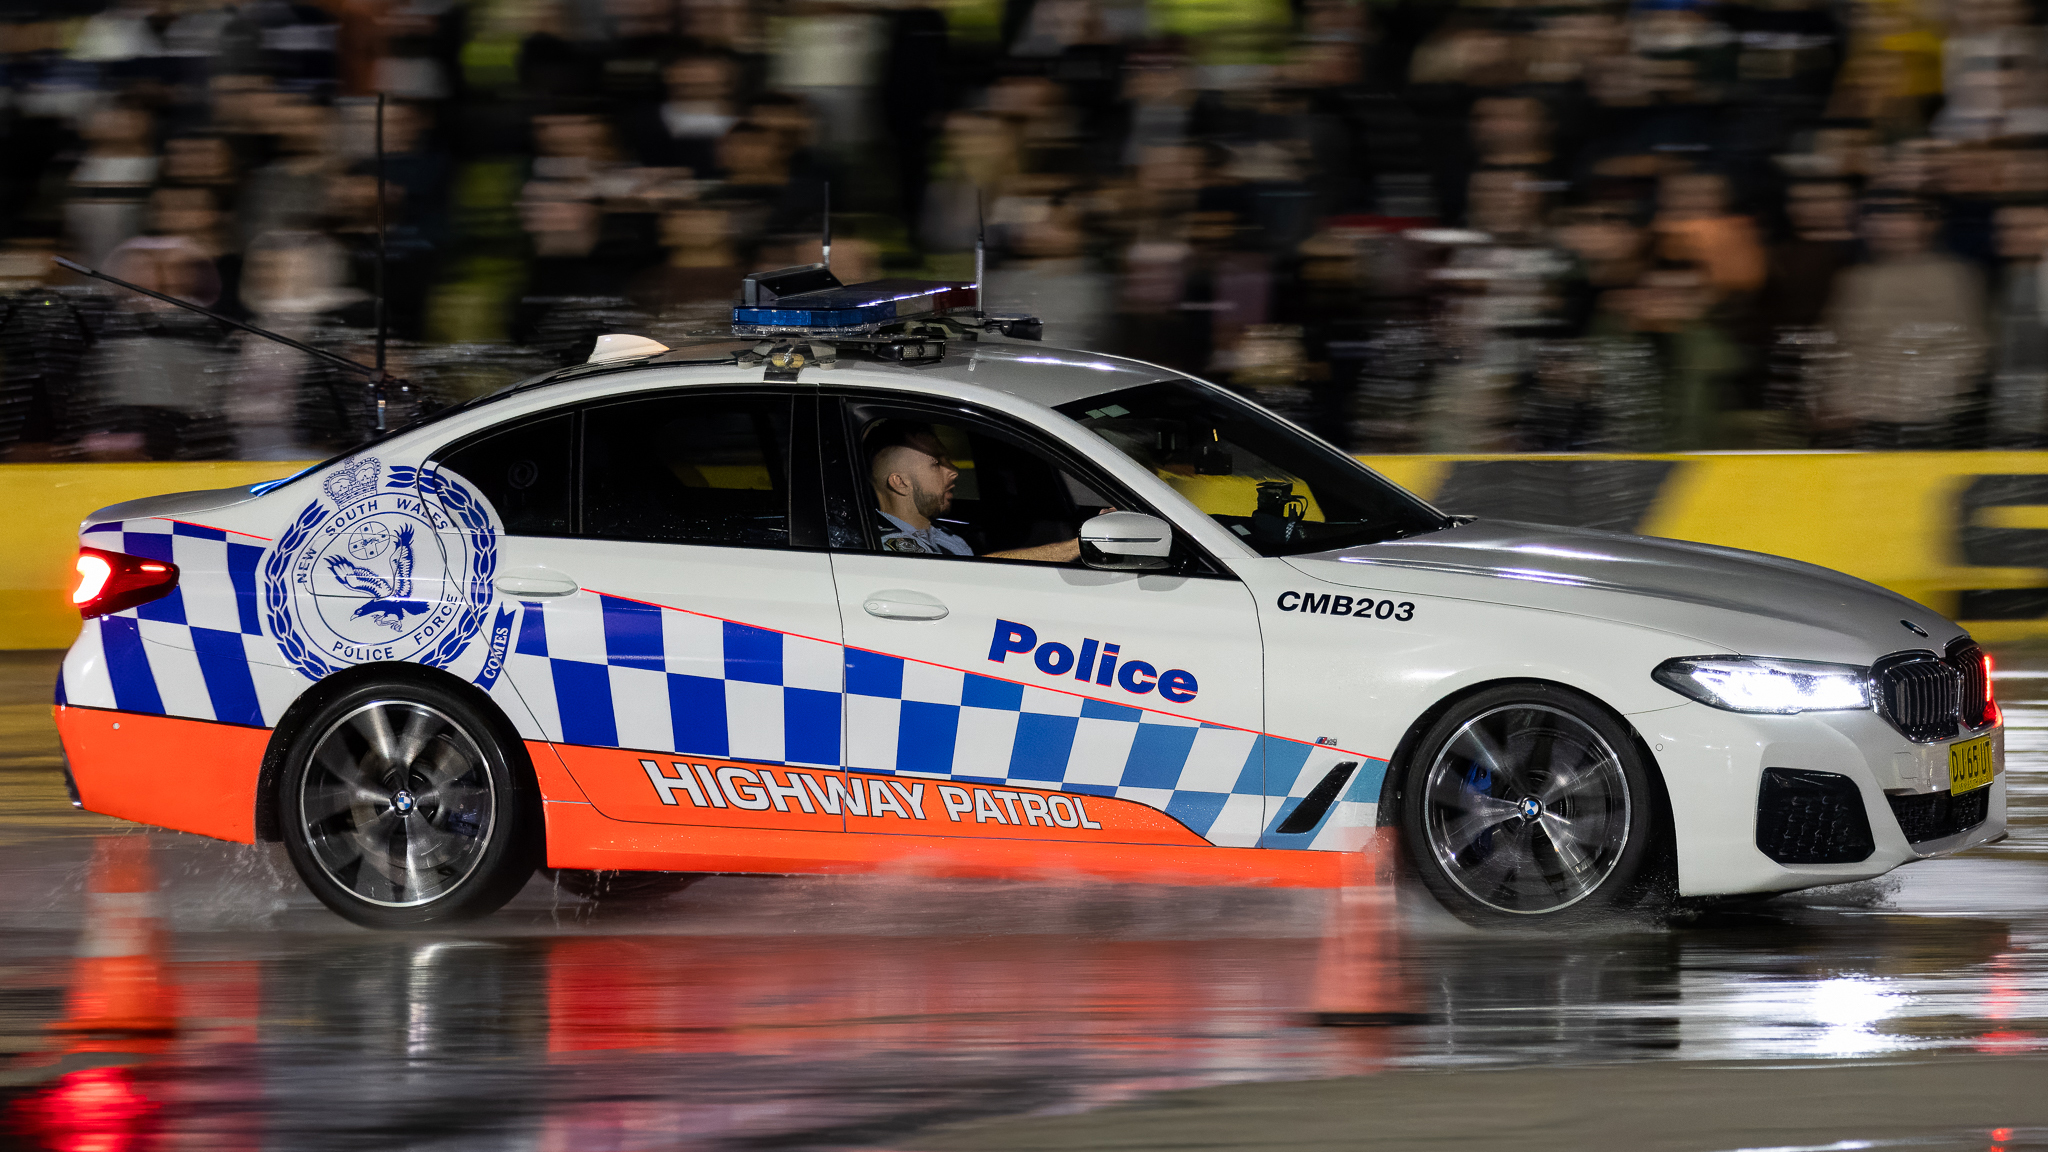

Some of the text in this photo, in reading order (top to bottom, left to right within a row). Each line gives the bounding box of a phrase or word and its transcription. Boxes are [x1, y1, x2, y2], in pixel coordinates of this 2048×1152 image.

[297, 548, 317, 584] NEW
[325, 500, 378, 537] SOUTH
[333, 594, 458, 661] POLICE FORCE
[1276, 591, 1416, 622] CMB203
[483, 627, 509, 679] COMES
[987, 618, 1199, 704] Police
[639, 759, 1103, 831] HIGHWAY PATROL
